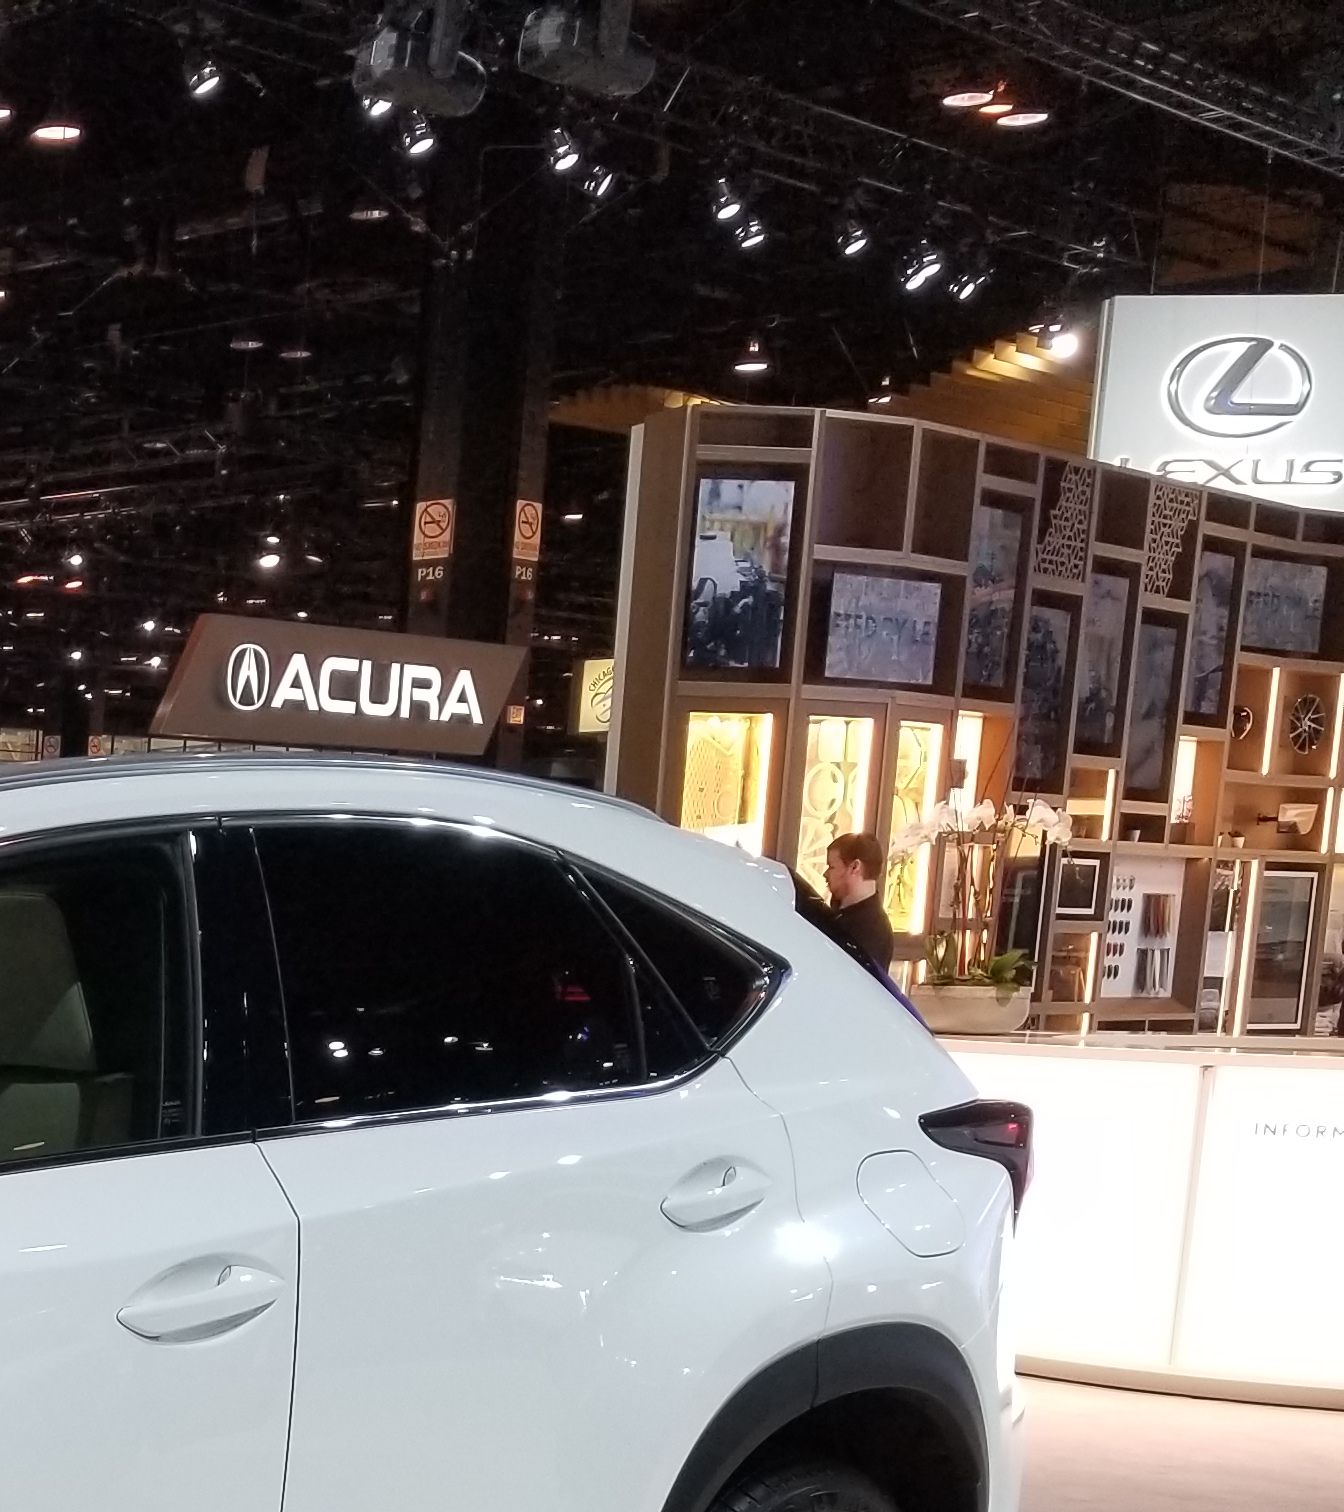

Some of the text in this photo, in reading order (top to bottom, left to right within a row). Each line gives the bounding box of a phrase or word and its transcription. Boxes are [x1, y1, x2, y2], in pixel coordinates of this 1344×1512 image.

[417, 566, 444, 582] P16
[514, 565, 533, 581] P16
[270, 653, 485, 725] ACURA
[588, 664, 615, 692] CHICAG
